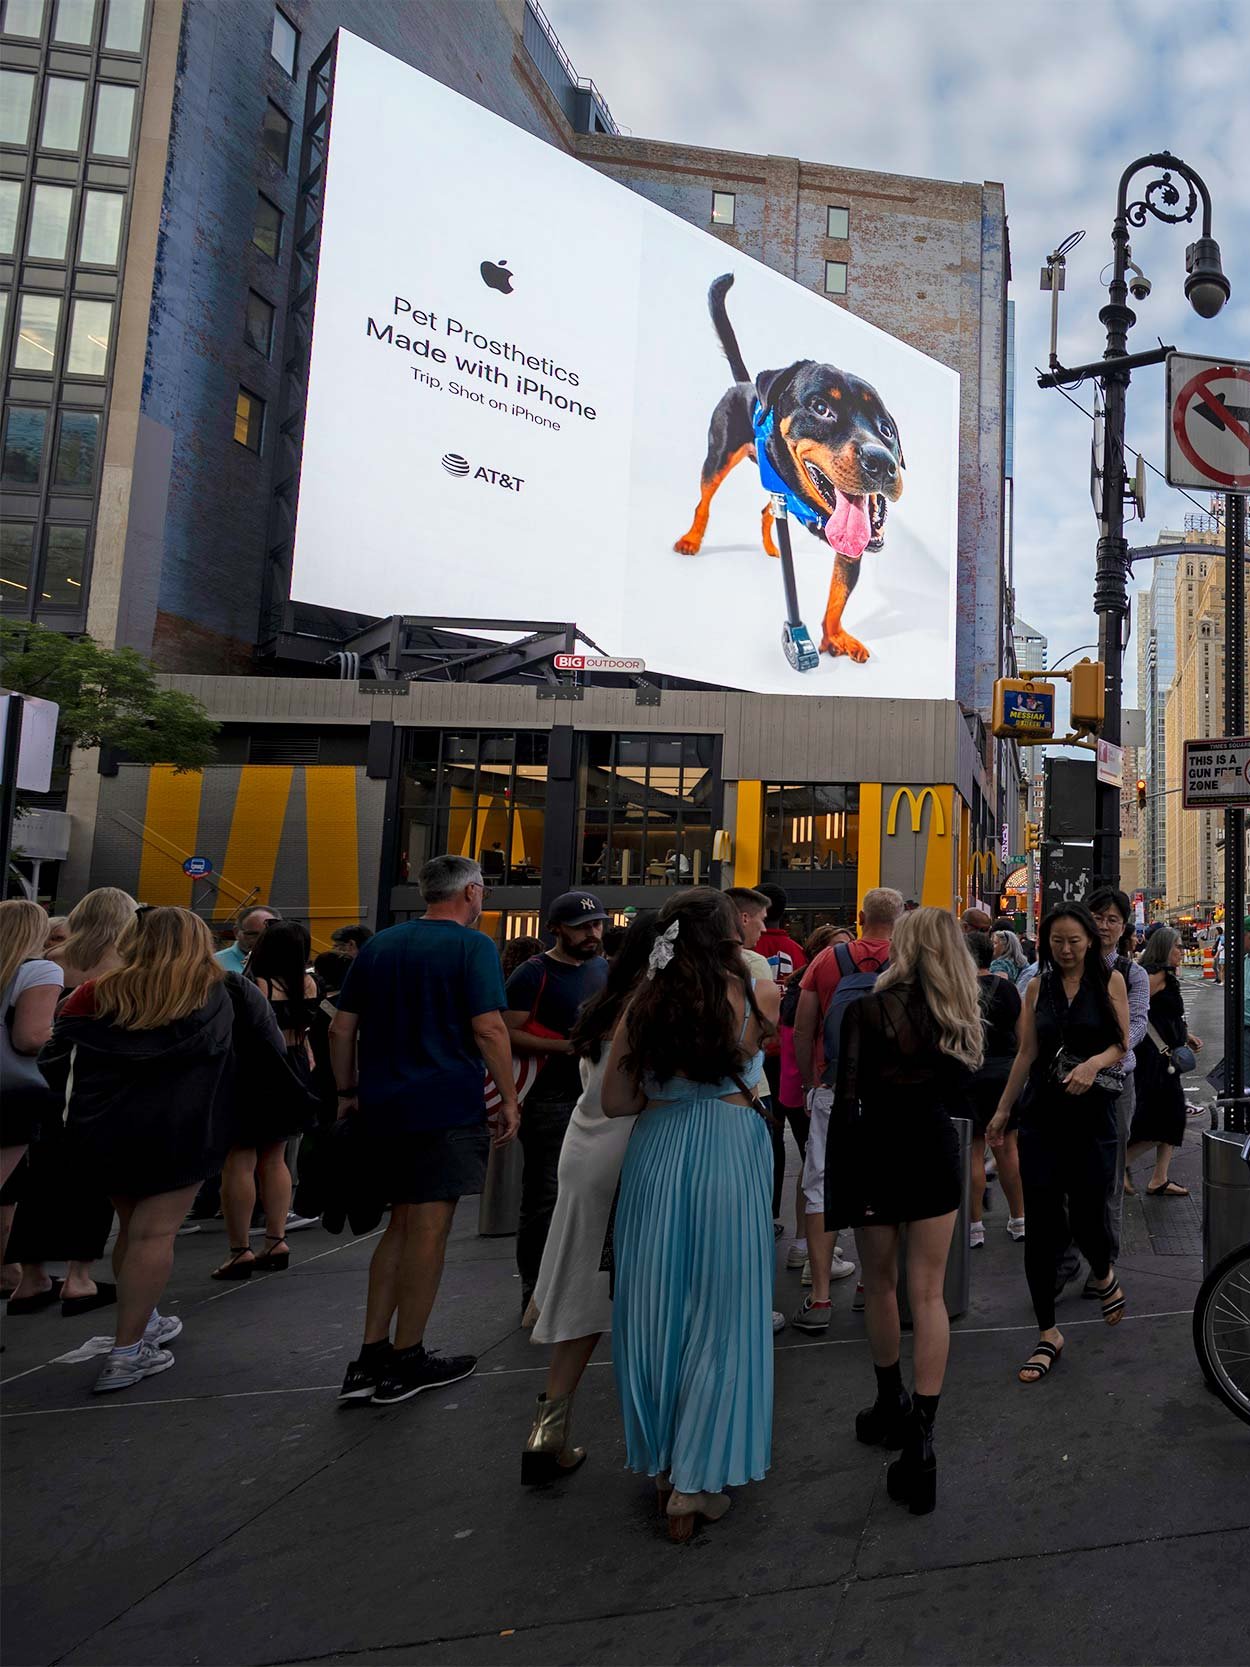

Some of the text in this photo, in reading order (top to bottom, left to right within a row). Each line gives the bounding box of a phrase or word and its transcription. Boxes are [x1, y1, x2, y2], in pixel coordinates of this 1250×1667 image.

[394, 296, 580, 387] Pet Prosthetics
[366, 317, 597, 421] Made with iPhone
[410, 367, 561, 431] Trip, Shot on iPhone
[474, 467, 525, 492] AT&T
[559, 656, 640, 668] BIG OUTDOOR
[1009, 710, 1045, 720] MESSIAH
[1189, 754, 1237, 766] THIS IS A
[1189, 768, 1211, 779] GUN
[1189, 781, 1219, 791] ZONE
